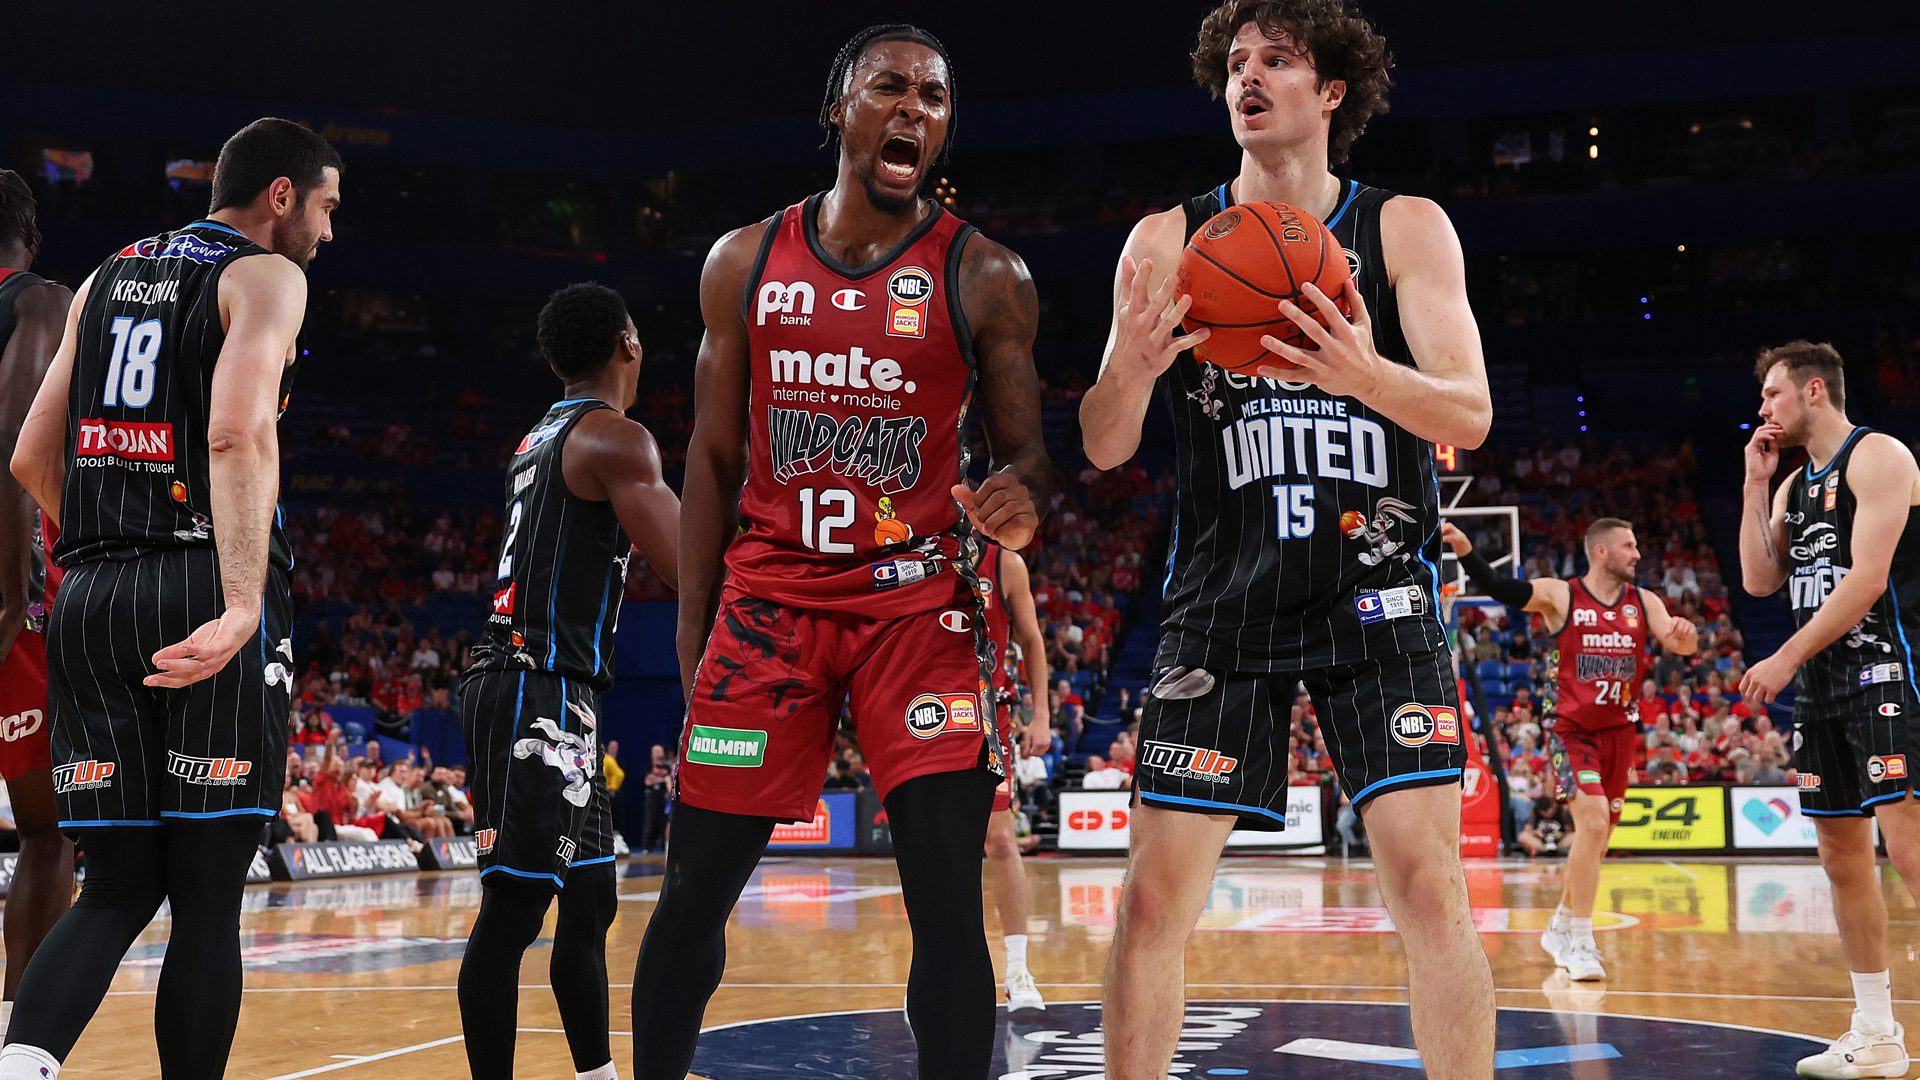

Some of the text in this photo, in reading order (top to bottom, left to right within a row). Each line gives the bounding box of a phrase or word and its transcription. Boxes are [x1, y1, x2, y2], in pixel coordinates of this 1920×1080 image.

[897, 278, 923, 296] NBL
[780, 314, 812, 326] bank
[102, 316, 163, 409] 18
[769, 346, 917, 394] mate.
[772, 385, 902, 411] internet mobile
[1241, 397, 1347, 419] MELBOURNE
[80, 424, 168, 454] TROJAN
[768, 404, 928, 495] WILDCATS
[1222, 414, 1389, 490] UNITED
[76, 455, 175, 474] TOOLS BUILT TOUGH
[799, 487, 856, 554] 12
[1272, 484, 1316, 539] 15
[497, 500, 523, 580] 2
[900, 561, 918, 572] SINCE
[1385, 595, 1405, 604] SINCE
[490, 613, 512, 625] OUGH
[1582, 631, 1637, 648] mate.
[1594, 680, 1622, 705] 24
[913, 707, 940, 727] NBL
[1399, 715, 1428, 734] NBL
[691, 736, 759, 757] HOLMAN
[64, 779, 112, 792] LABOUR
[195, 778, 247, 786] LABOUR
[1174, 768, 1231, 784] LABOUR
[1616, 797, 1701, 827] C4
[301, 847, 334, 874] ALL
